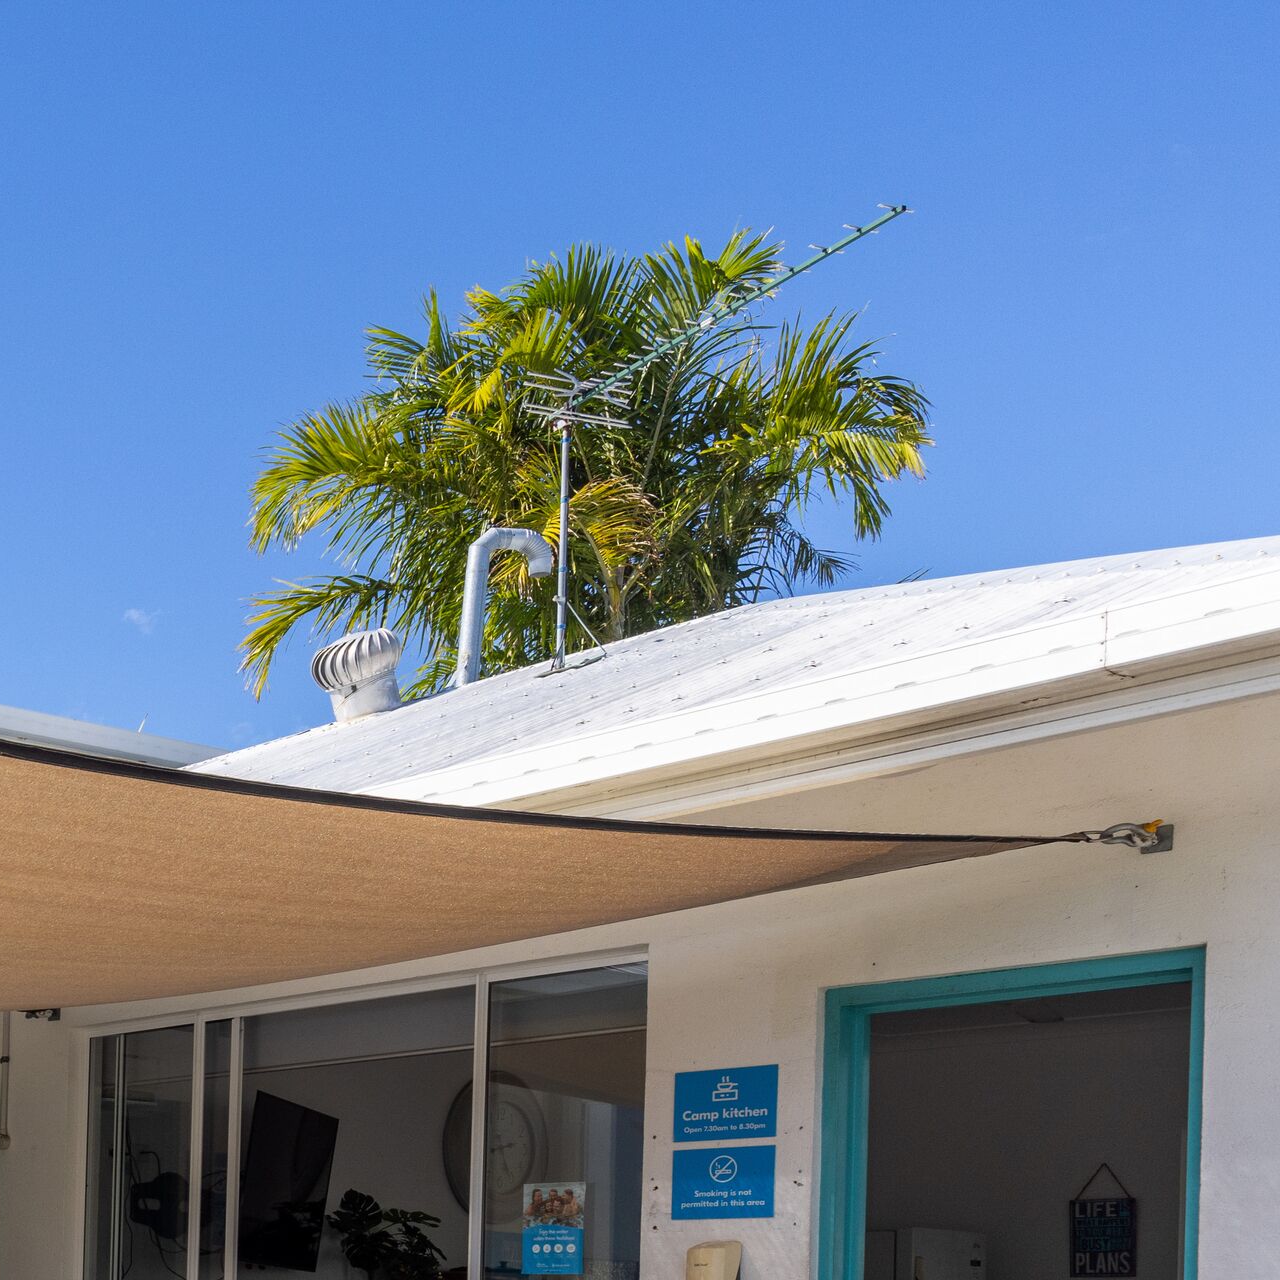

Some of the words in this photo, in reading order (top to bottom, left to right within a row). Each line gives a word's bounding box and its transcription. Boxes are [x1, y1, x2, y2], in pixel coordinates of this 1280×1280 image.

[682, 1110, 719, 1122] Camp
[722, 1106, 768, 1119] kitchen
[683, 1126, 703, 1134] Open
[694, 1190, 728, 1198] Smoking
[681, 1200, 719, 1209] permitted
[1074, 1201, 1118, 1218] LIFE
[1074, 1251, 1131, 1274] PLANS
